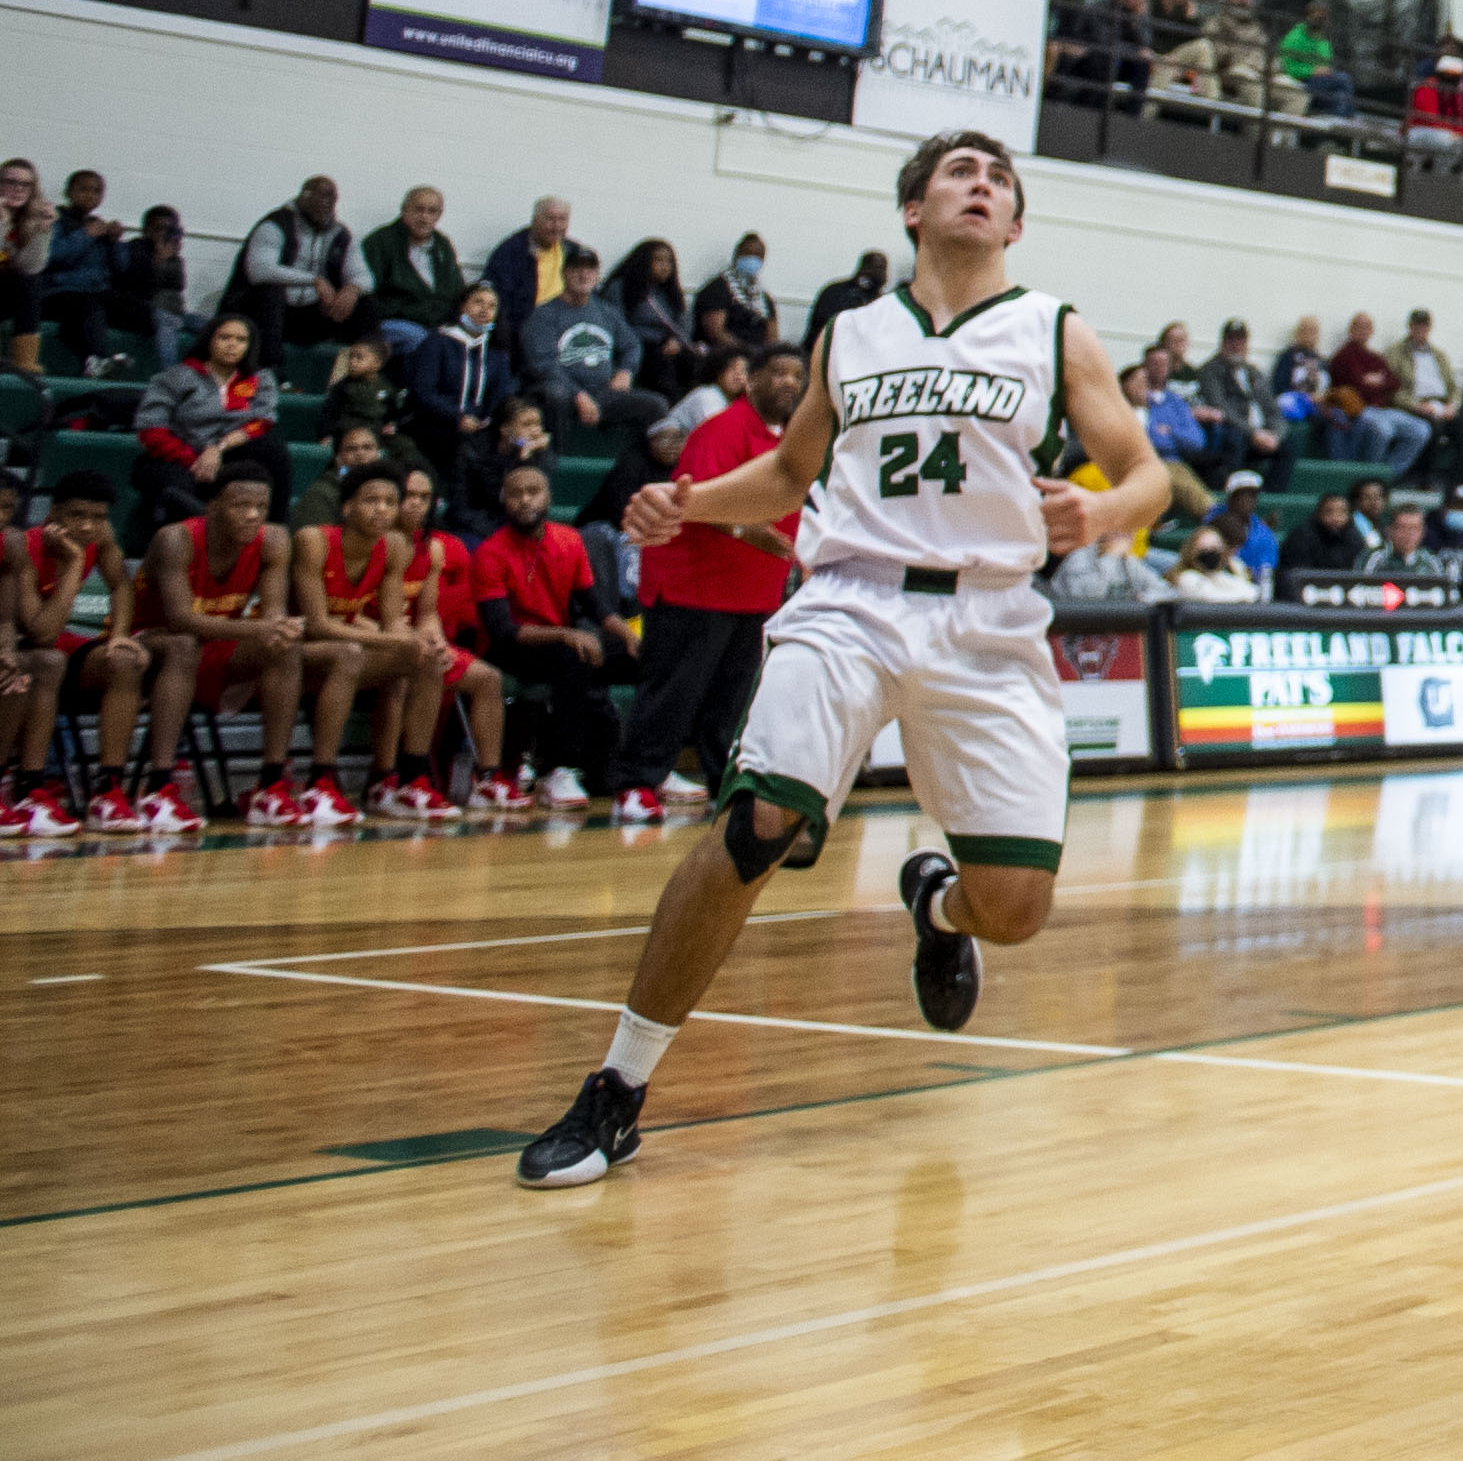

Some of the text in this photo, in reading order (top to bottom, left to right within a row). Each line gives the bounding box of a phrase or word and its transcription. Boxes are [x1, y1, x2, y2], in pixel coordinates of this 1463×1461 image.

[842, 367, 1025, 430] FREELAND
[880, 432, 966, 498] 24
[1229, 633, 1390, 667] FREELAND
